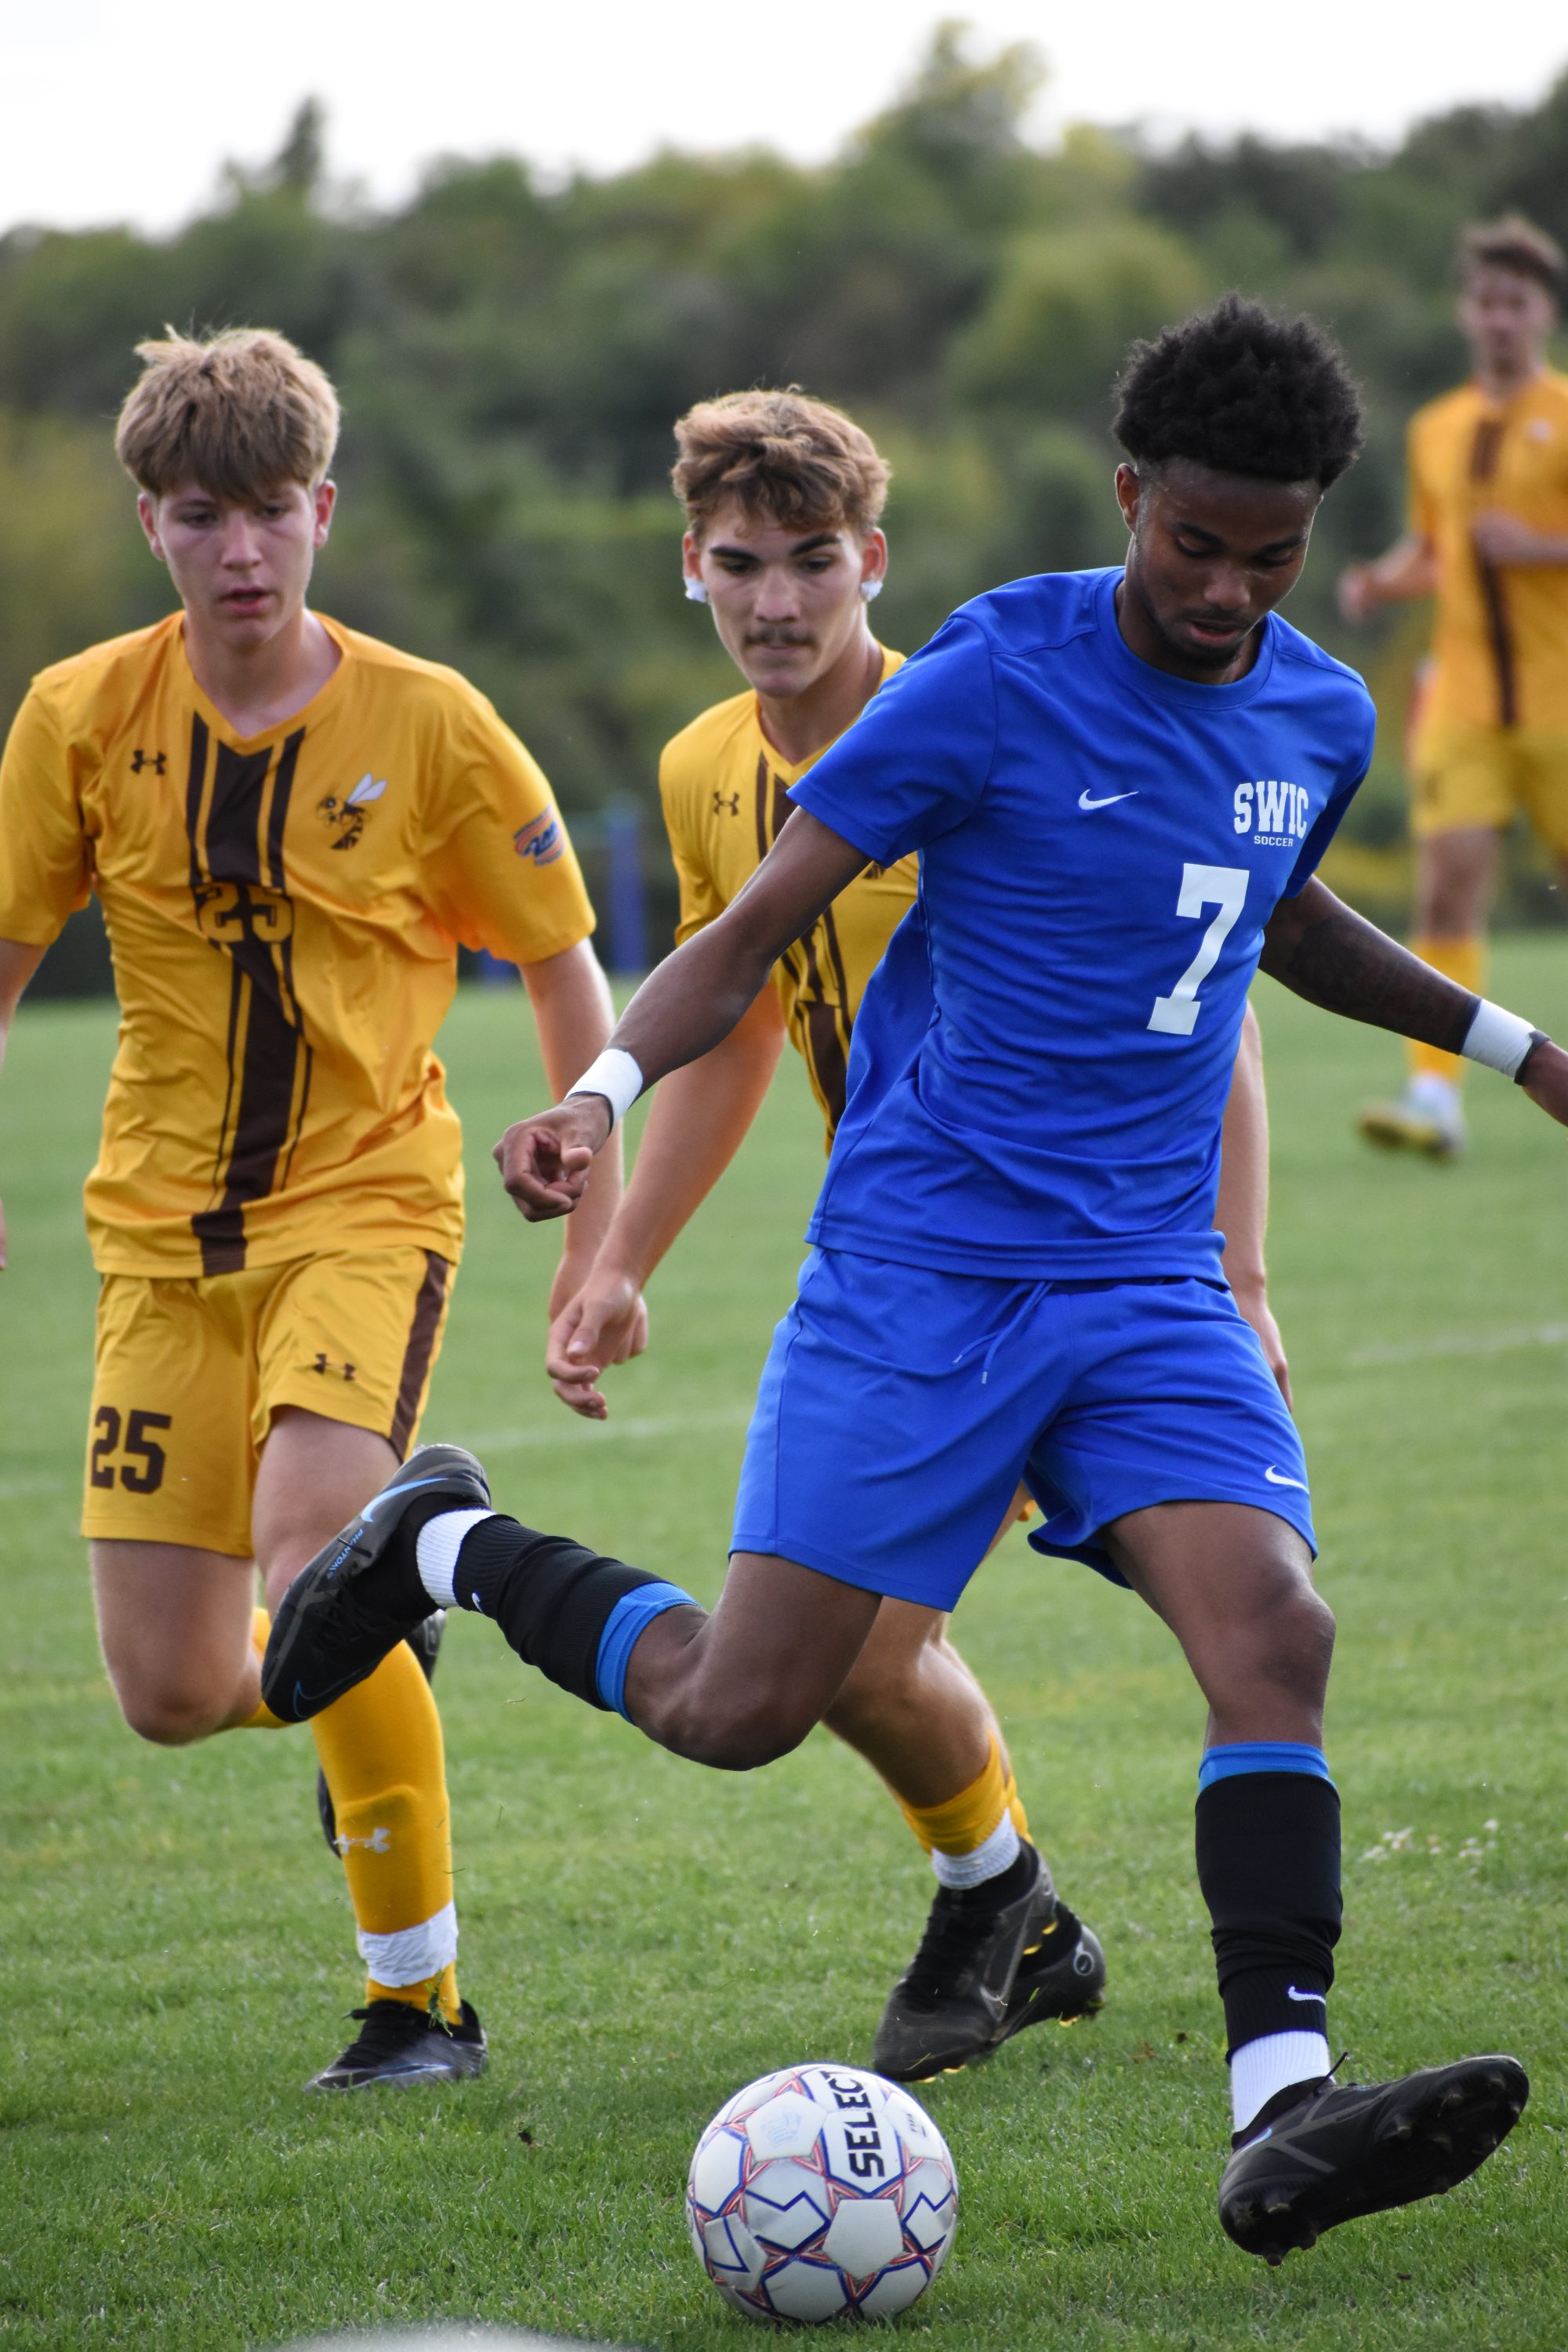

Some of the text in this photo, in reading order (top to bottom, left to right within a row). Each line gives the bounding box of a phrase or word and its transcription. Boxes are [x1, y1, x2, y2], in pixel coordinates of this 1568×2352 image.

[1234, 780, 1308, 839] SWIC
[1254, 835, 1294, 847] SOCCER
[195, 882, 294, 942] 25
[1147, 863, 1250, 1035] 7
[90, 1406, 172, 1495] 25
